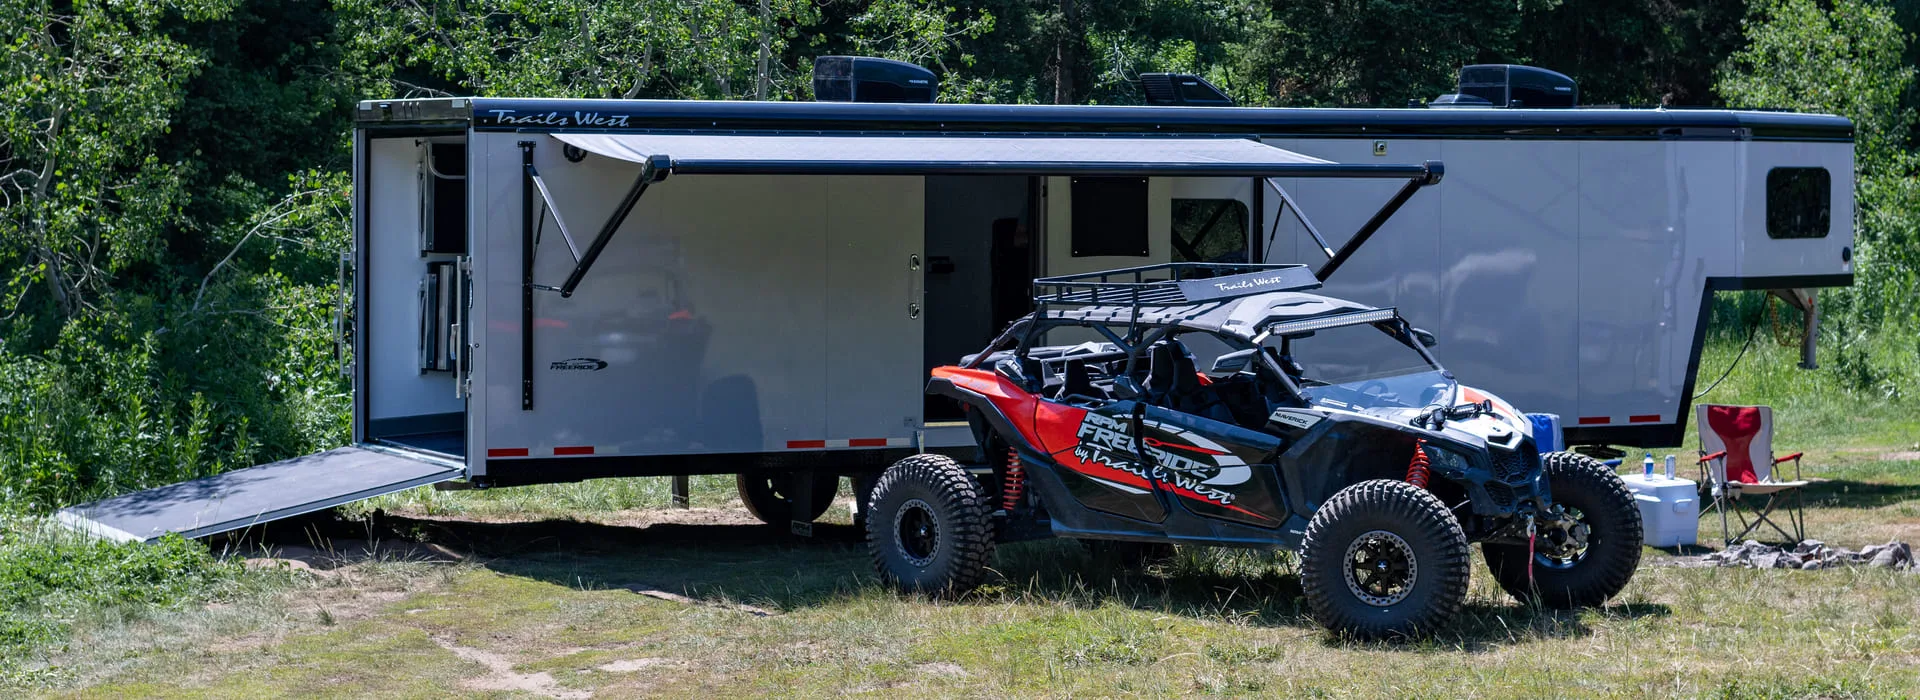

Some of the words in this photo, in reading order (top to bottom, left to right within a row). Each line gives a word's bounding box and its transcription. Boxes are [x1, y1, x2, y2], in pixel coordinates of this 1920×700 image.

[489, 109, 568, 125] Trails
[574, 111, 629, 127] West
[1214, 281, 1254, 292] Trails
[1253, 276, 1281, 286] West
[1084, 412, 1128, 433] RPM
[1274, 412, 1309, 424] MAVERICK
[1074, 441, 1089, 464] by
[1086, 442, 1169, 483] Trails
[1174, 472, 1231, 504] West
